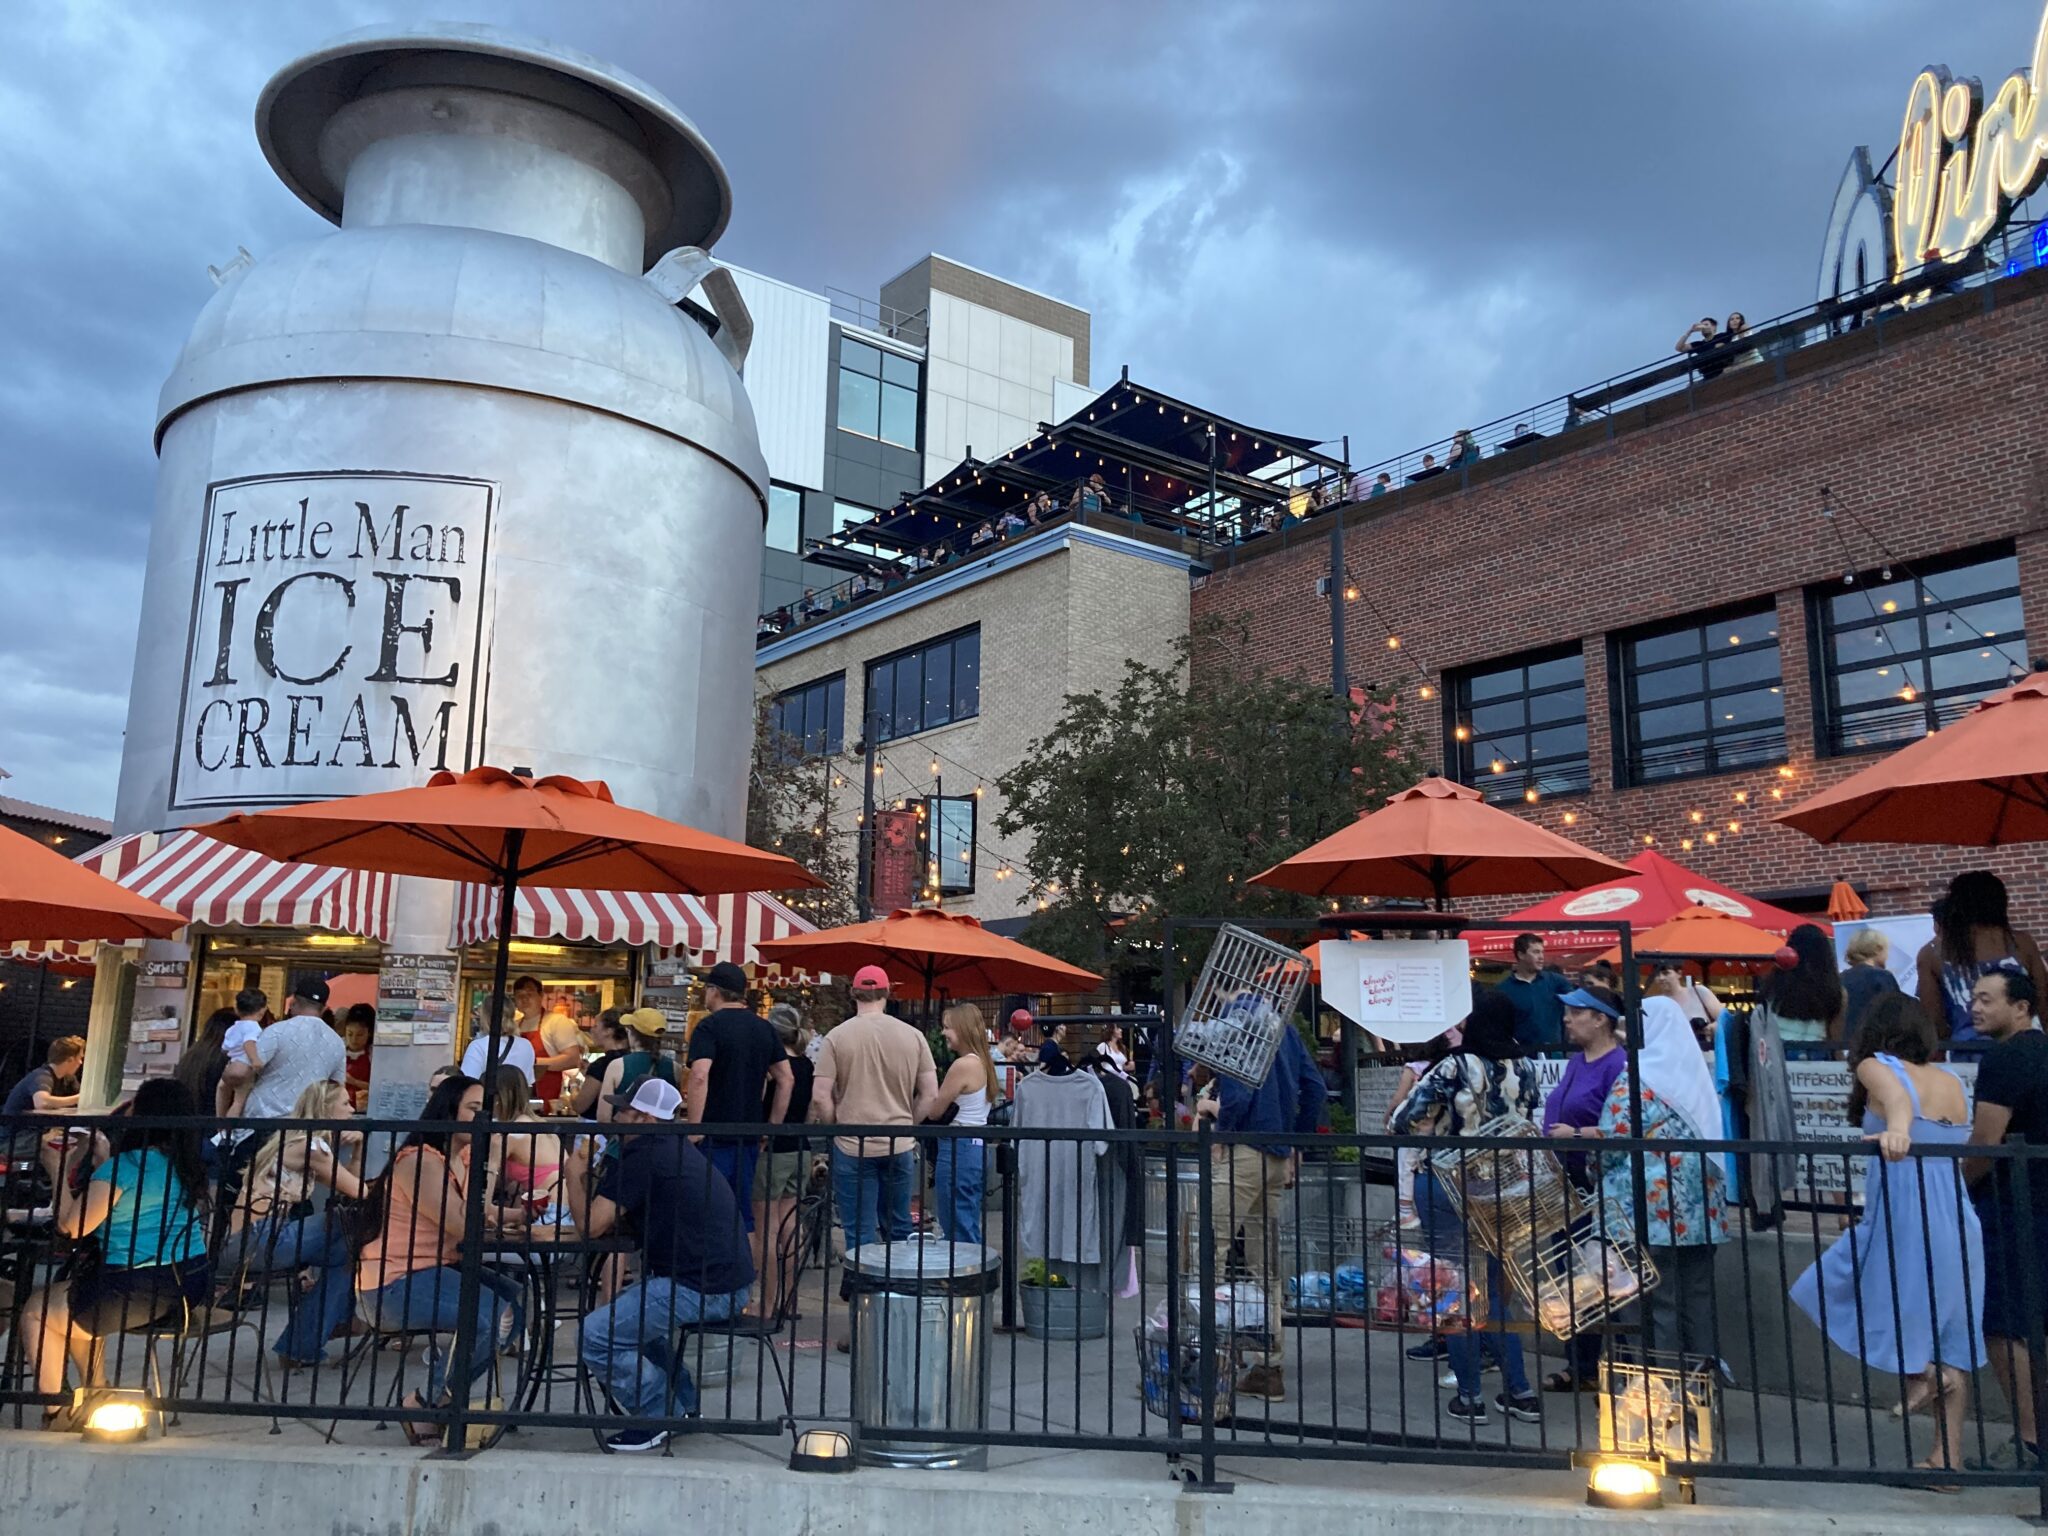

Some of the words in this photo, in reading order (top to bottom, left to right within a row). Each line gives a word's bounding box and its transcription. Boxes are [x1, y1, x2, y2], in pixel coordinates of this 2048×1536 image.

[215, 497, 333, 567] Little
[348, 501, 467, 563] Man
[203, 571, 462, 688] ICE
[195, 693, 459, 772] CREAM
[146, 962, 176, 976] Sorbet
[392, 954, 416, 968] Ice
[417, 955, 446, 969] Cream
[380, 977, 416, 989] CHOCOLATE
[1795, 1113, 1814, 1124] oop
